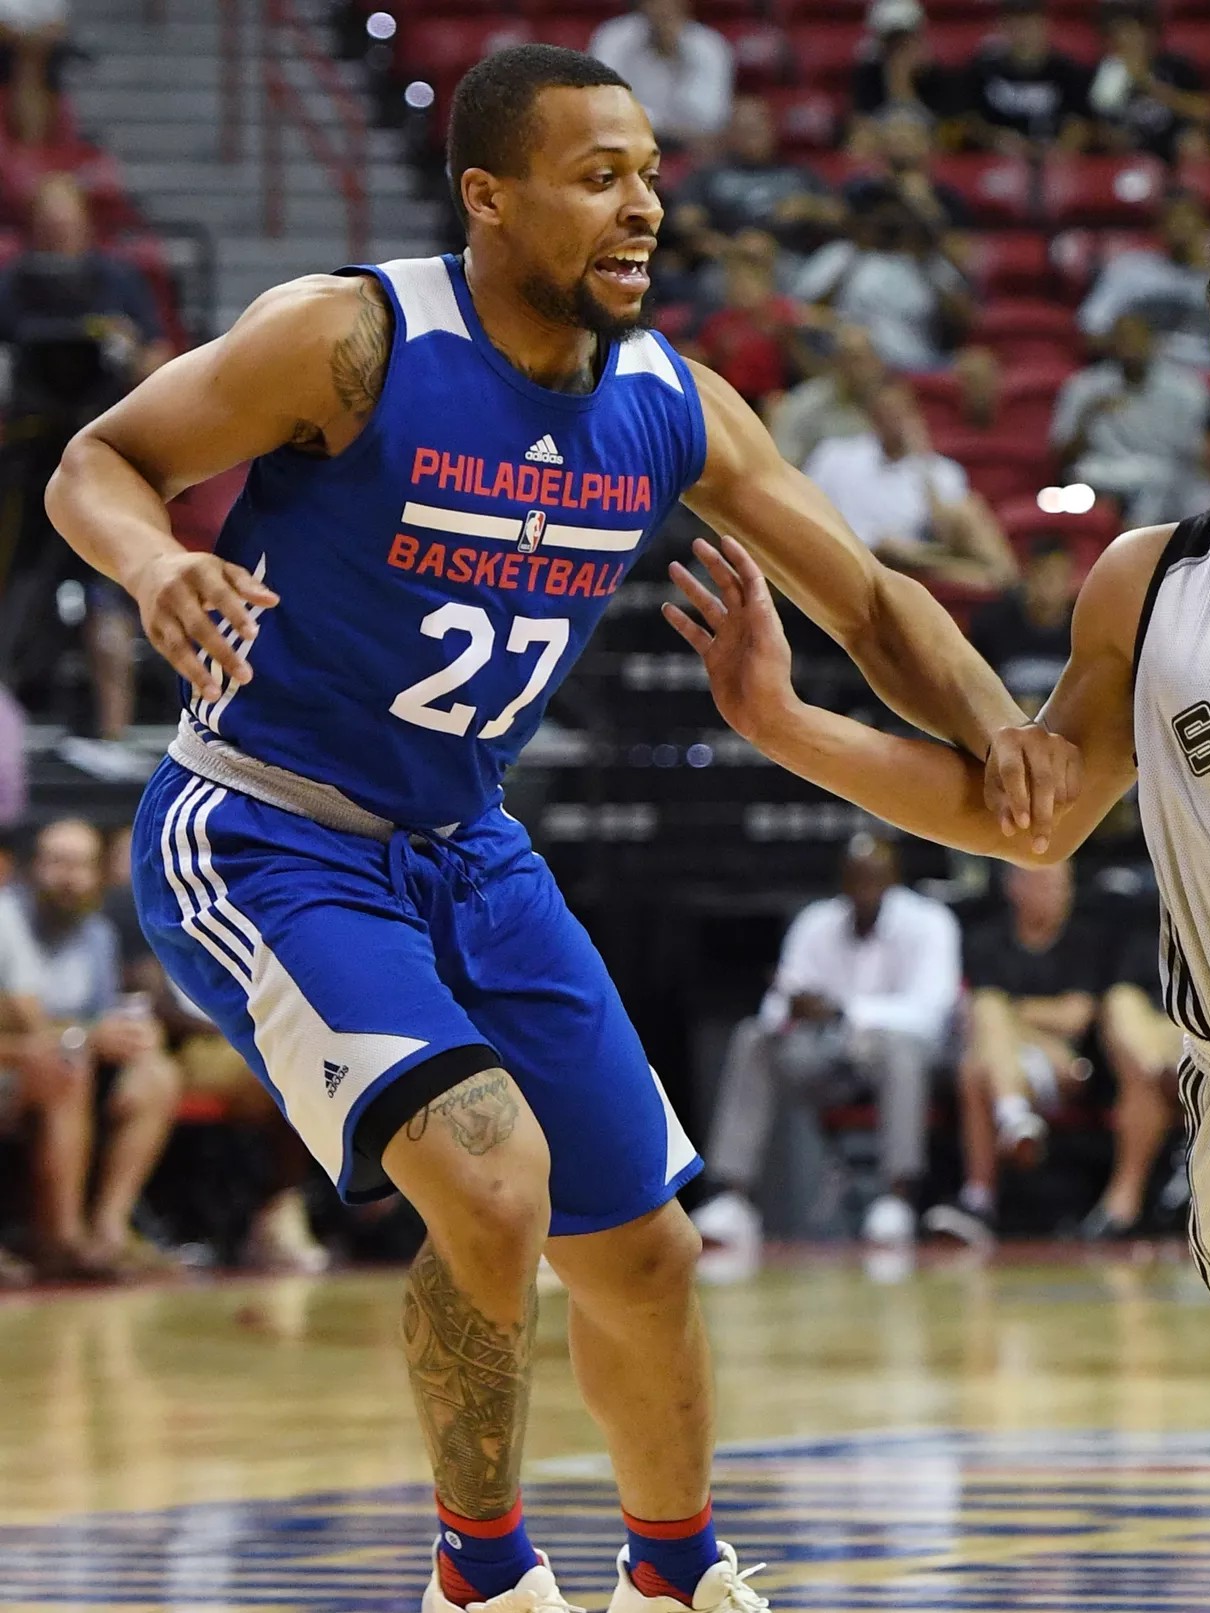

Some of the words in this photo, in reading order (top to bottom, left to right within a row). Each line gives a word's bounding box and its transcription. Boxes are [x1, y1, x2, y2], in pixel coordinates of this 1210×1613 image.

[411, 447, 651, 512] PHILADELPHIA
[525, 450, 564, 465] adidas
[388, 602, 570, 739] 27
[327, 1064, 349, 1099] adidas
